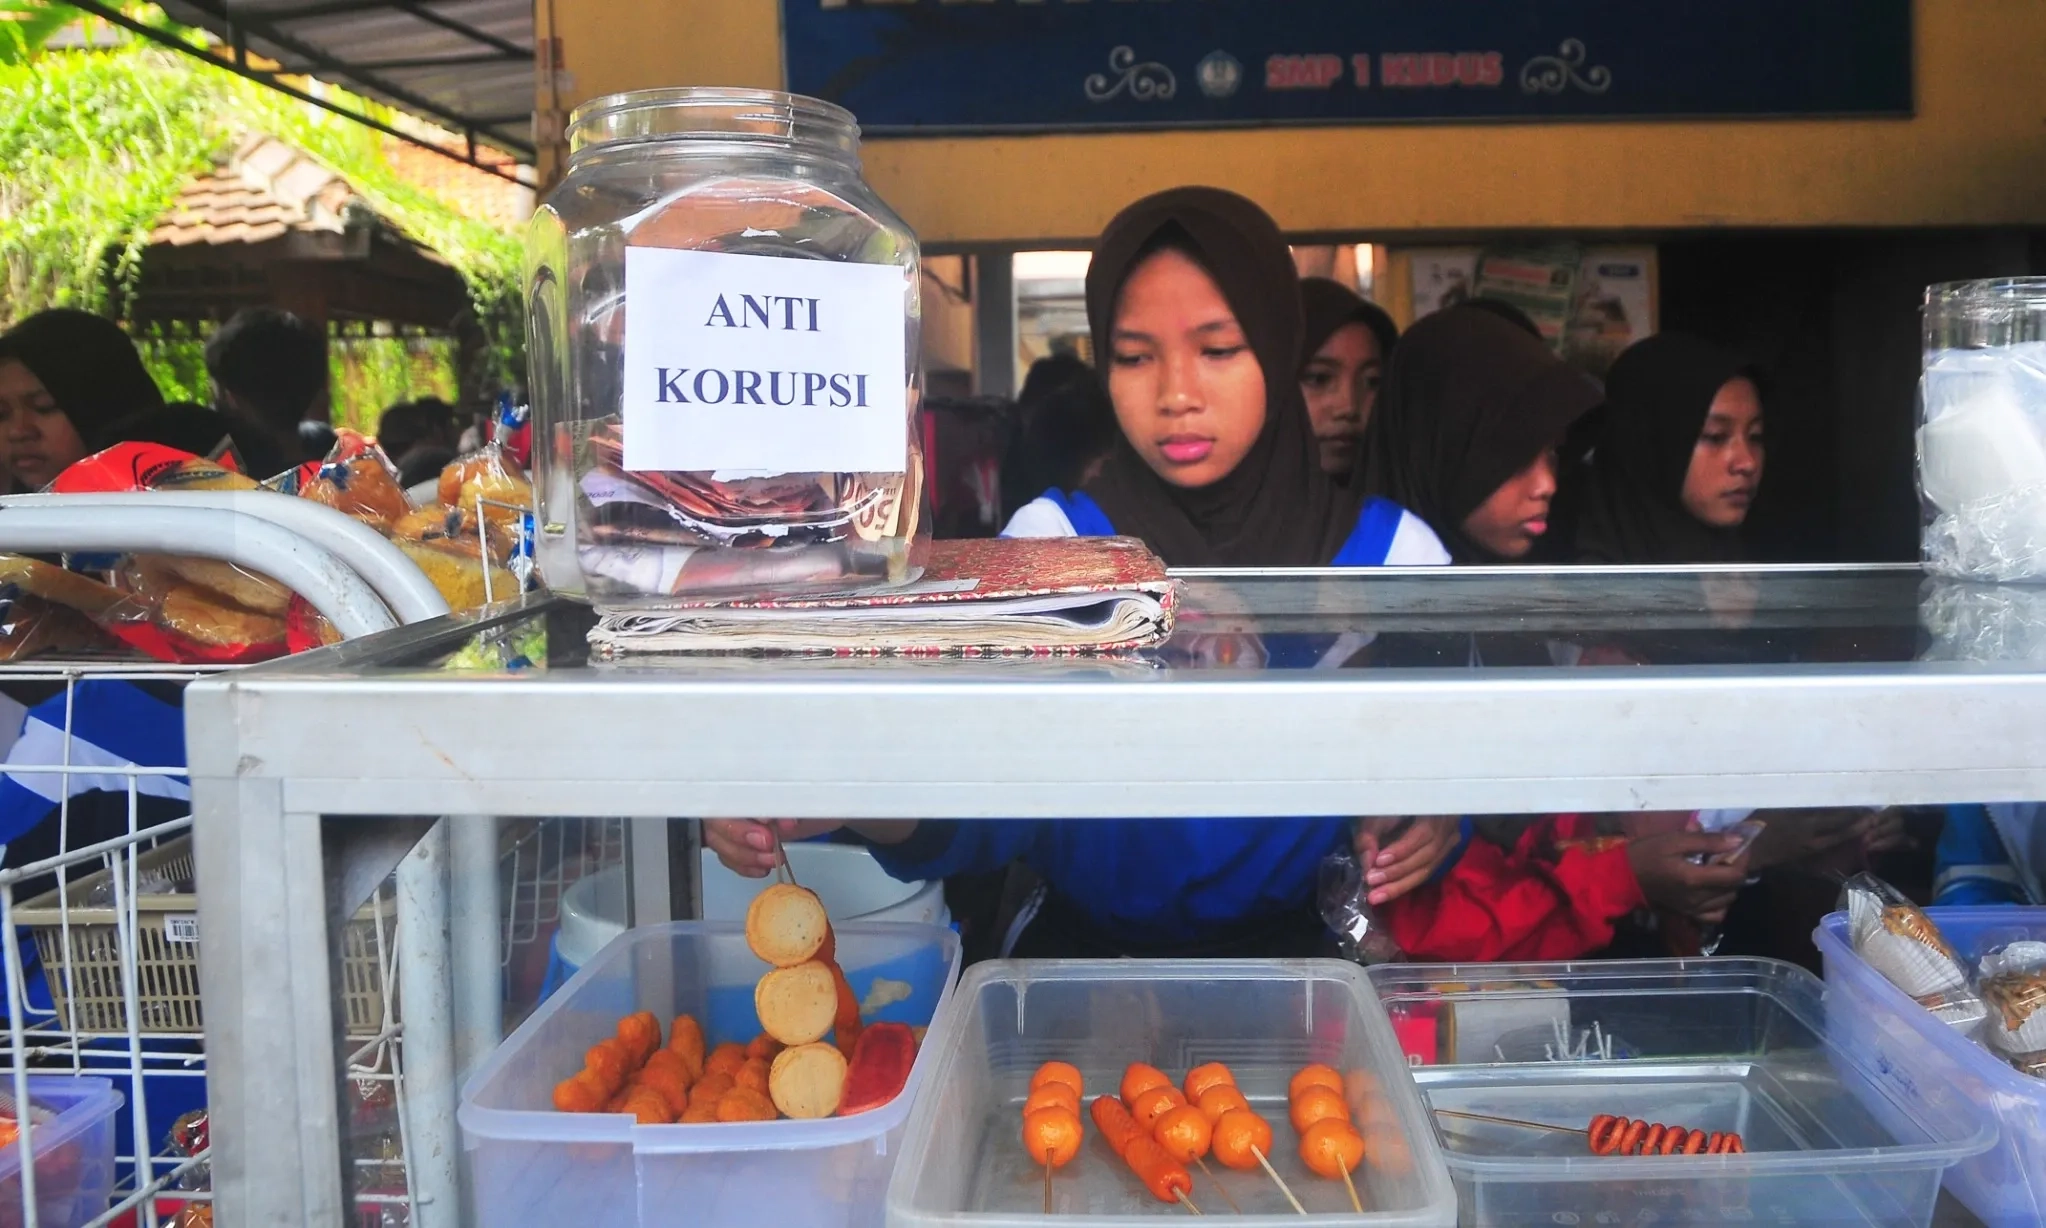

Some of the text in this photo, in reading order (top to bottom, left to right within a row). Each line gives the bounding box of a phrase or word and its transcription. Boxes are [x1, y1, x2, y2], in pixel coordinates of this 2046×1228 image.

[1265, 51, 1503, 89] SMP 1 KUDUS
[704, 292, 821, 332] ANTI
[654, 366, 870, 407] KORUPSI
